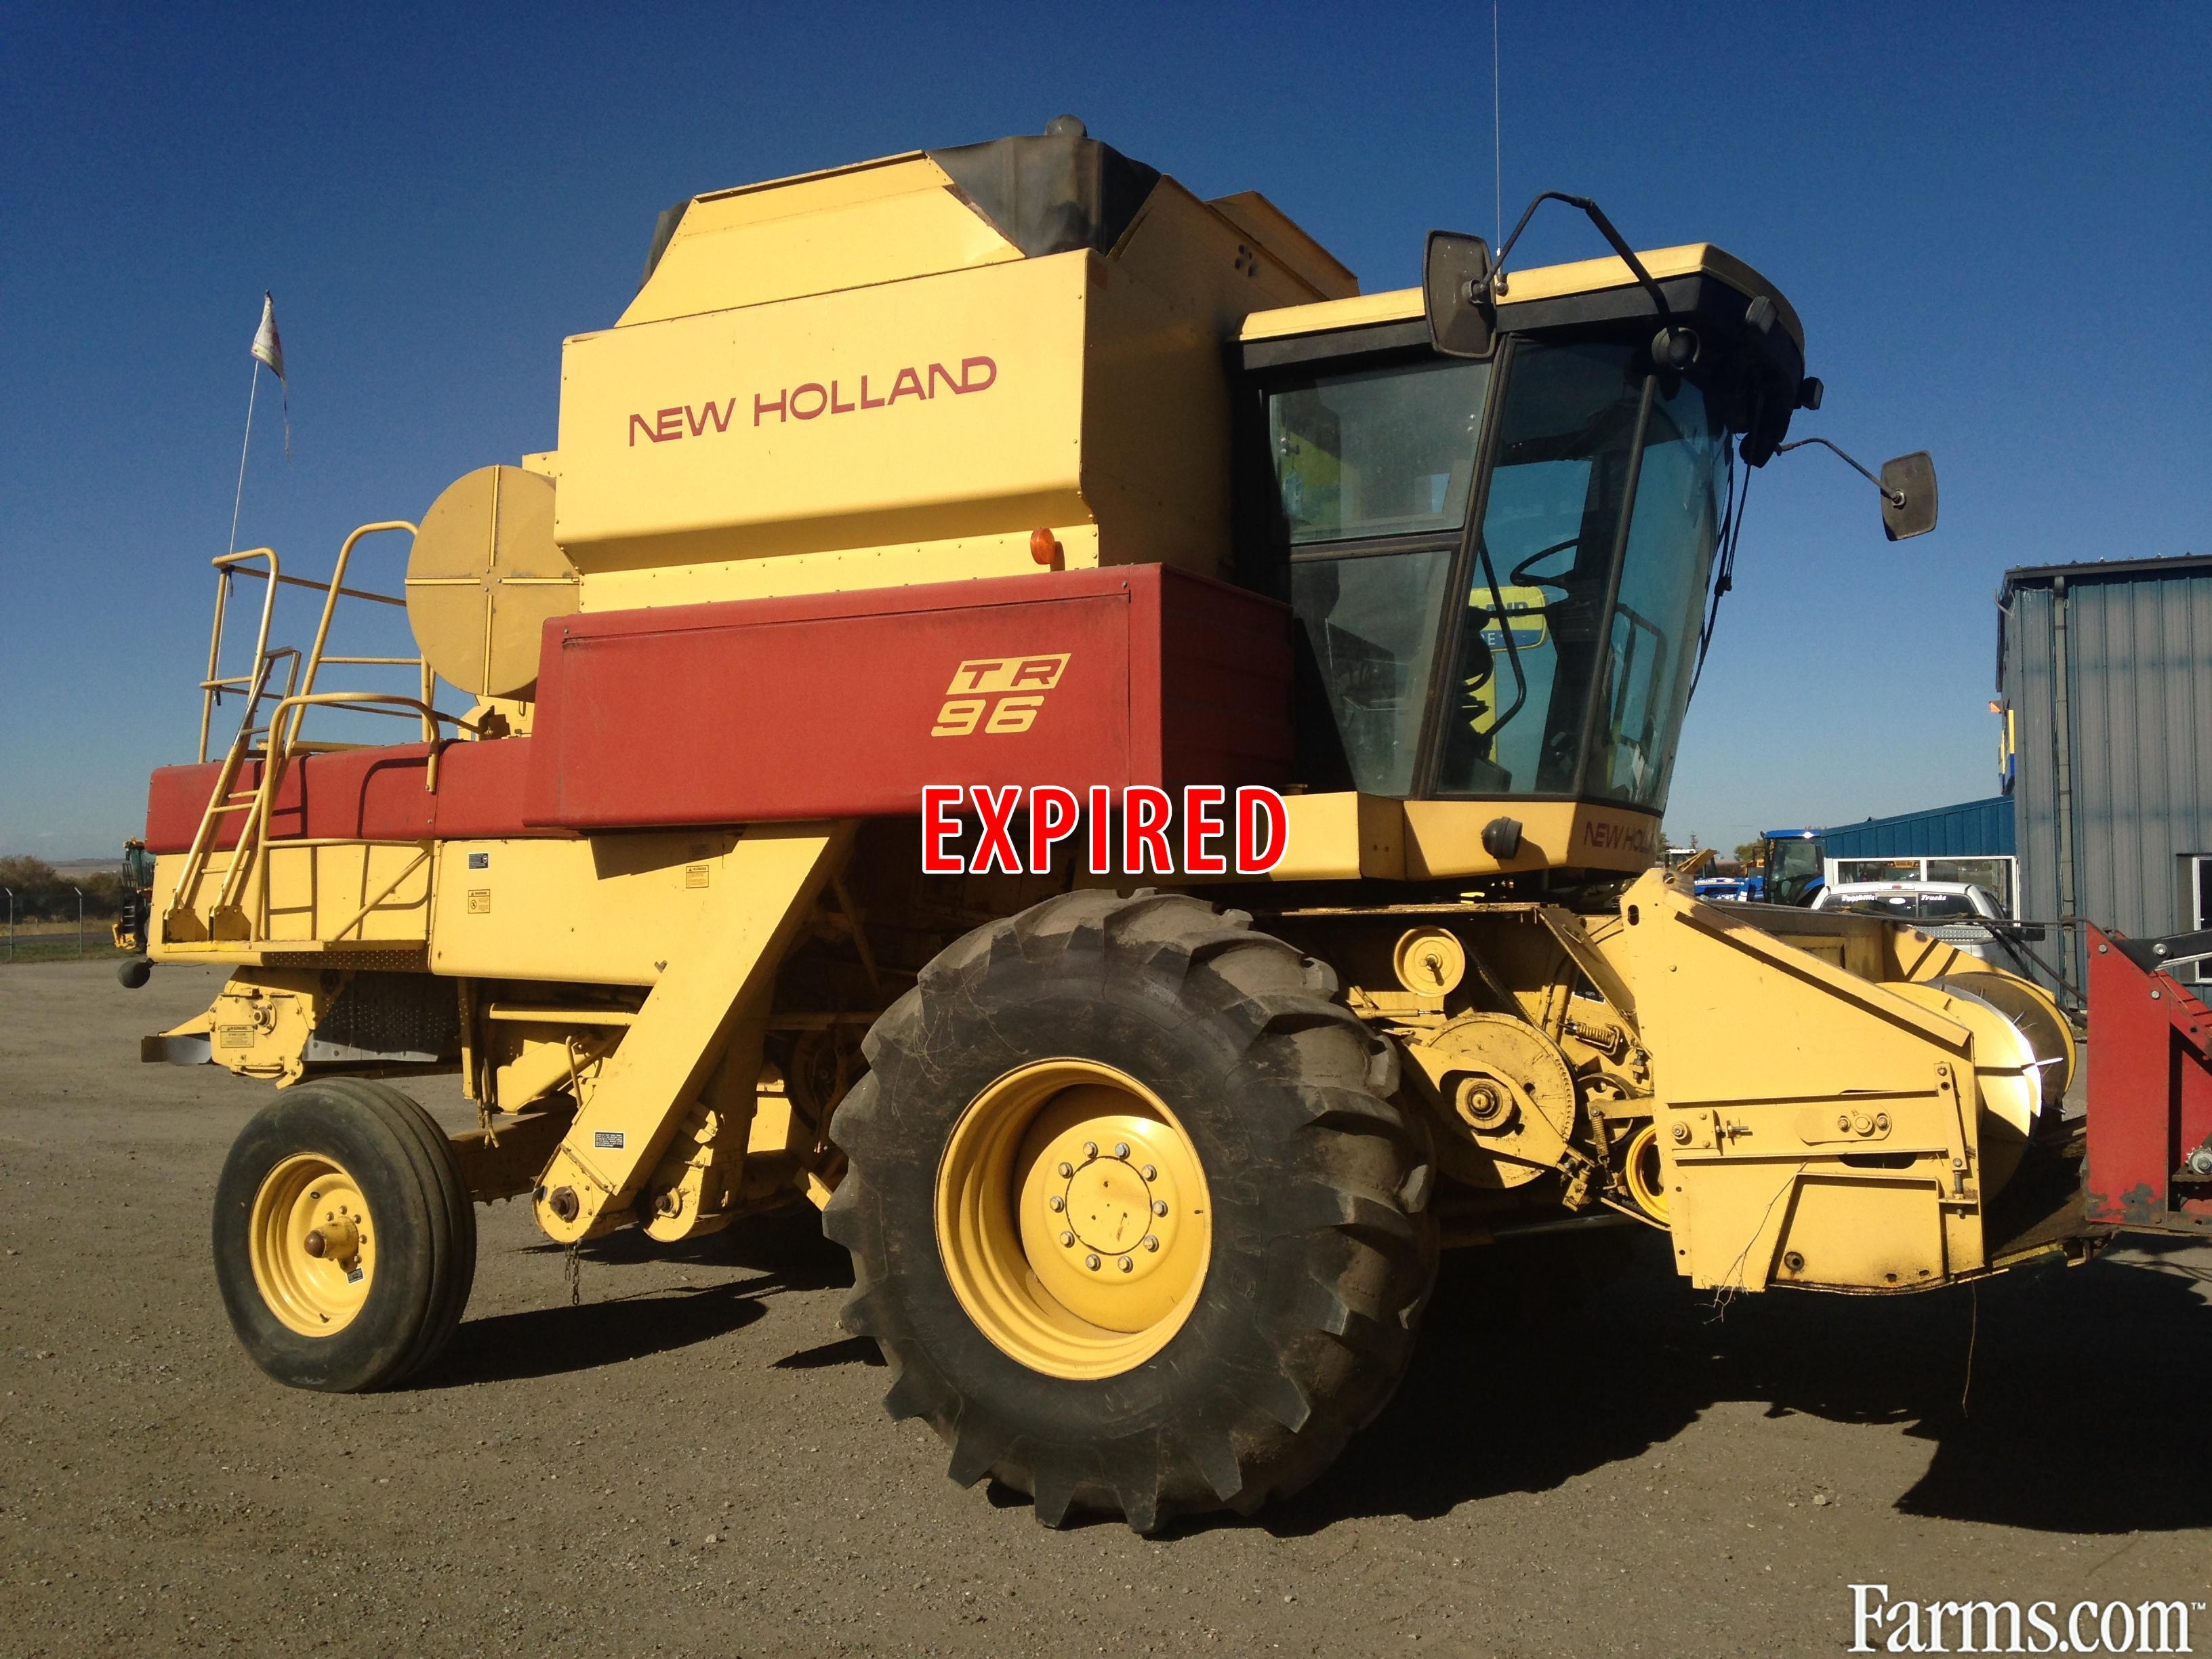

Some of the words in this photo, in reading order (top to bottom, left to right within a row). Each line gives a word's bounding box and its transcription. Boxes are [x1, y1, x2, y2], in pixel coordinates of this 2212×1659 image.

[629, 397, 737, 447] NEW
[754, 356, 998, 427] HOLLAND
[958, 658, 1063, 689] TR
[930, 695, 1046, 737] 96
[1583, 821, 1624, 850] NEW
[1622, 825, 1656, 854] HOLL
